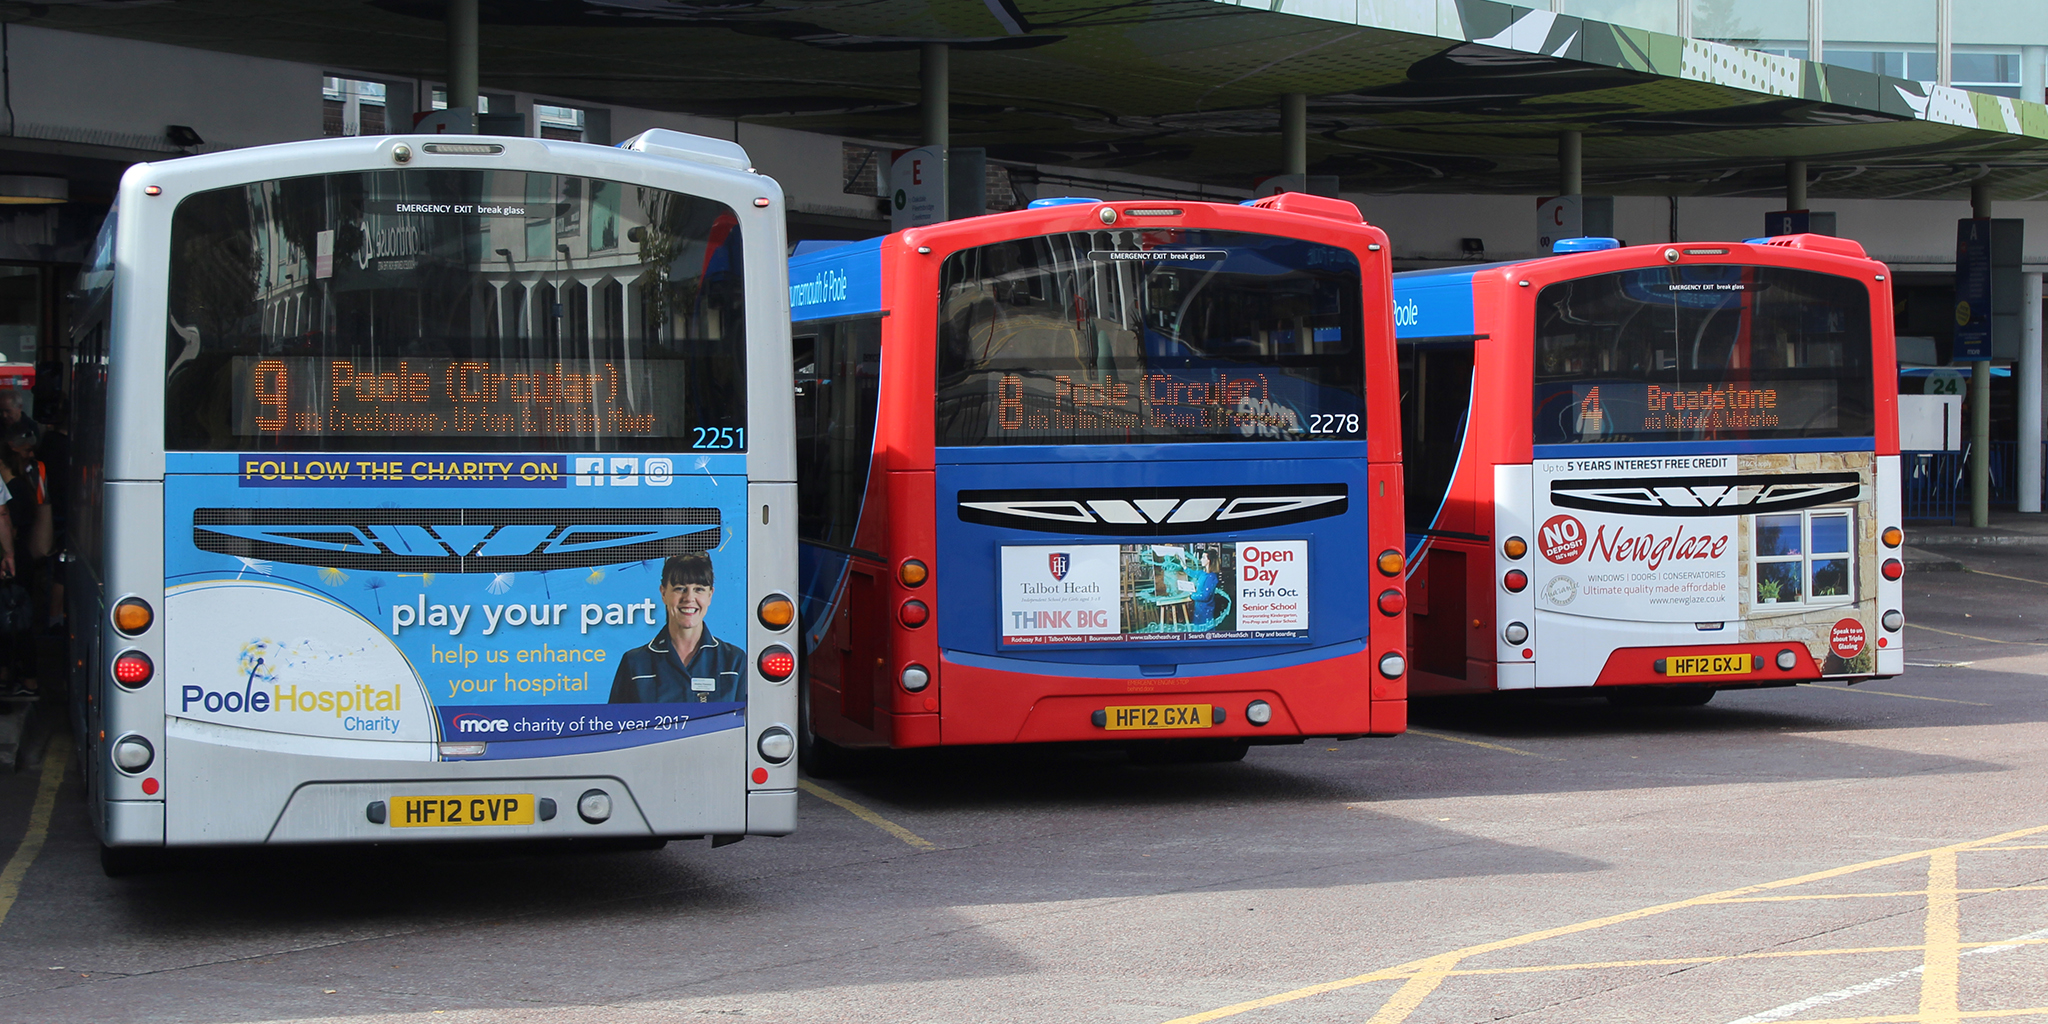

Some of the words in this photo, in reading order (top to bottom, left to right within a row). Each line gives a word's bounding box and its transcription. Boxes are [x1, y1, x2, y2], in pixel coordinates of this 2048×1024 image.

[912, 159, 922, 185] E
[396, 203, 450, 213] EMERGENCY
[454, 205, 473, 213] EXIT
[478, 205, 502, 214] break
[503, 206, 525, 216] glass
[1554, 205, 1563, 226] C
[1783, 217, 1792, 235] B
[1970, 224, 1977, 240] A
[1110, 252, 1150, 260] EMERGENCY
[1189, 253, 1206, 261] glass
[789, 272, 822, 307] urnemouth
[823, 271, 828, 302] &
[829, 268, 847, 301] Poole
[255, 360, 288, 431] 9
[332, 360, 430, 402] Poole
[446, 361, 617, 403] (Circular)
[1933, 378, 1957, 394] 24
[999, 375, 1023, 430] 8
[1055, 375, 1128, 406] Poole
[1139, 373, 1268, 406] (Circular)
[1581, 386, 1602, 431] 4
[1647, 383, 1777, 411] Broadstone
[329, 405, 448, 432] Creekmoor,
[522, 407, 537, 432] &
[545, 407, 600, 432] Turlin
[608, 407, 656, 432] Moor
[1200, 408, 1213, 427] &
[1309, 413, 1359, 433] 2278
[1644, 412, 1661, 429] via
[1665, 411, 1709, 428] Oakdale
[1713, 411, 1722, 428] &
[1726, 410, 1779, 427] Waterloo
[692, 427, 745, 449] 2251
[246, 461, 349, 481] FOLLOW
[357, 462, 403, 481] THE
[411, 462, 514, 482] CHARITY
[520, 462, 558, 482] ON
[1542, 463, 1554, 473] Up
[1555, 464, 1564, 472] to
[1567, 462, 1574, 471] 5
[1576, 461, 1612, 471] YEARS
[1613, 460, 1664, 470] INTEREST
[1664, 459, 1691, 469] FREE
[1693, 458, 1728, 468] CREDIT
[1542, 519, 1580, 548] NO
[1243, 546, 1294, 567] Open
[1546, 539, 1584, 556] DEPOSIT
[1588, 524, 1729, 571] Newglaze
[1243, 565, 1279, 586] Day
[1588, 573, 1625, 582] WINDOWS
[1631, 573, 1657, 581] DOORS
[1663, 571, 1726, 580] CONSERVATORIES
[1020, 582, 1060, 594] Talbot
[1064, 581, 1100, 594] Heath
[1243, 588, 1256, 597] Fri
[1259, 588, 1275, 597] 5th
[1277, 588, 1298, 597] Oct.
[1583, 585, 1622, 595] Ultimate
[1624, 584, 1654, 596] quality
[1656, 583, 1680, 593] made
[1681, 582, 1726, 592] affordable
[1243, 603, 1269, 611] Senior
[1270, 602, 1297, 610] School
[1649, 595, 1726, 605] www.newglaze.co.uk
[392, 594, 470, 636] play
[483, 602, 567, 636] your
[581, 597, 656, 635] part
[1011, 610, 1072, 629] THINK
[1077, 609, 1108, 628] BIG
[1833, 628, 1849, 636] Speak
[431, 644, 478, 668] help
[486, 647, 509, 663] us
[517, 643, 606, 663] enhance
[1676, 658, 1709, 673] HF12
[1713, 657, 1742, 671] GXJ
[449, 676, 497, 698] your
[505, 672, 588, 696] hospital
[344, 716, 400, 734] Charity
[460, 718, 509, 733] more
[513, 717, 565, 735] charity
[569, 716, 585, 732] of
[588, 716, 614, 732] the
[617, 719, 650, 735] year
[653, 716, 689, 731] 2017
[1116, 708, 1158, 726] HF12
[1164, 707, 1200, 725] GXA
[406, 800, 462, 823] HF12
[470, 799, 519, 822] GVP
